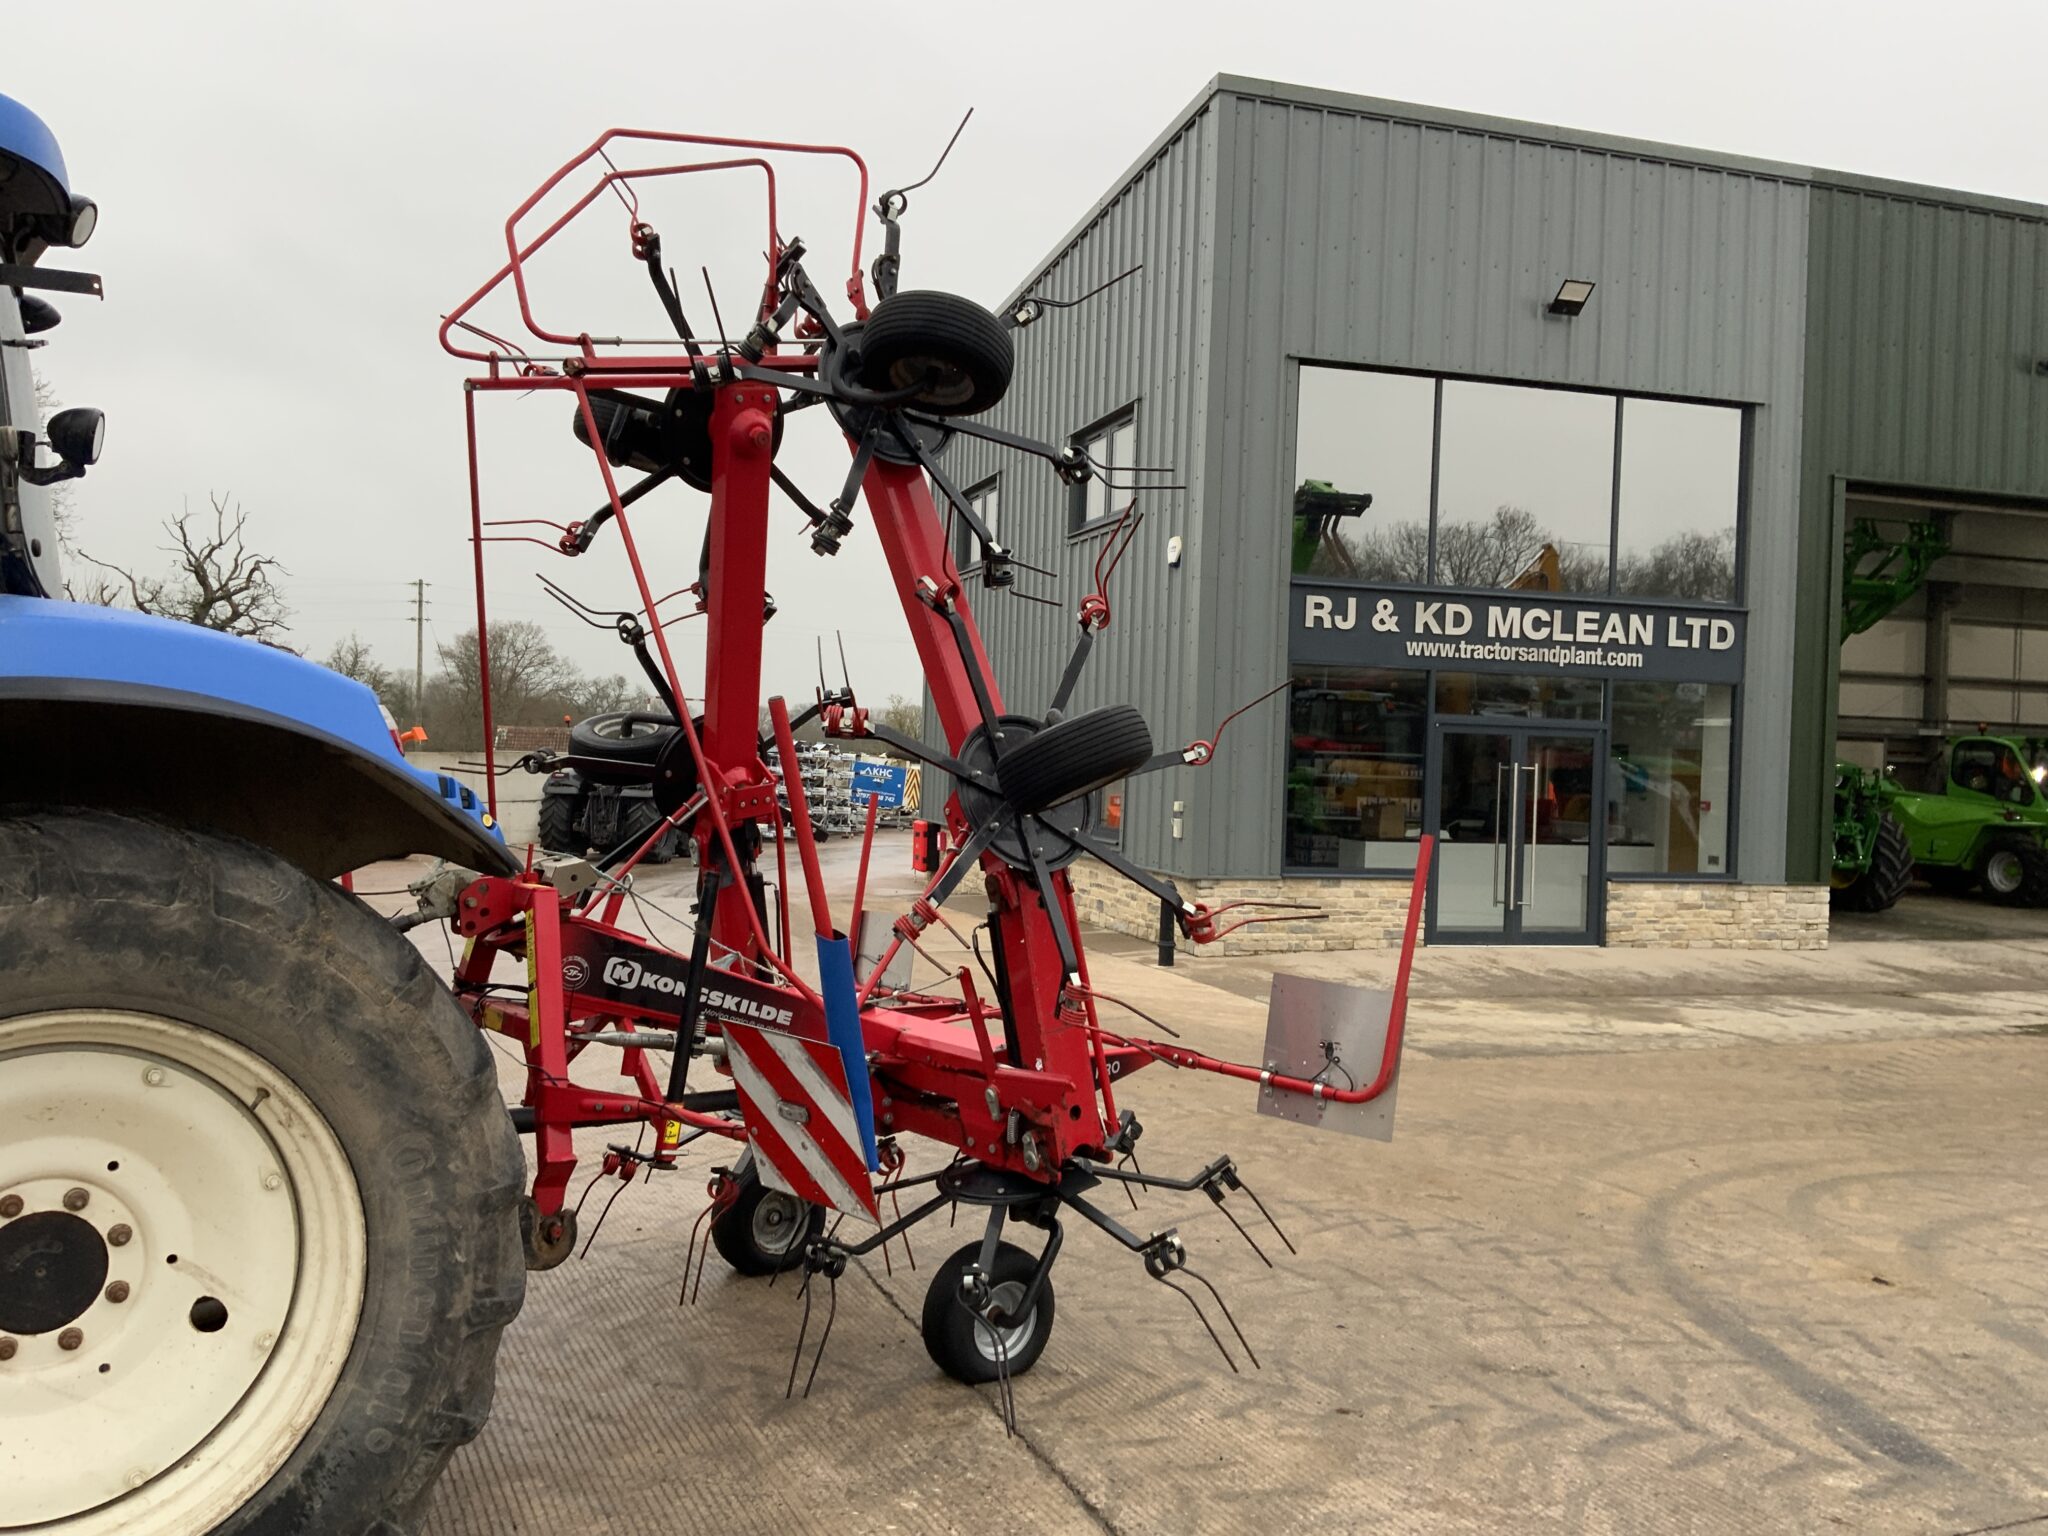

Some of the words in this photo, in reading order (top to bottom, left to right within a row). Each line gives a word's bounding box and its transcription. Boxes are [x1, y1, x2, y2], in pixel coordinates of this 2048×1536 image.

[1304, 595, 1357, 631] RJ
[1371, 598, 1400, 633] &
[1414, 601, 1473, 636] KD
[1487, 606, 1653, 646] MCLEAN
[1667, 615, 1736, 650] LTD
[1406, 639, 1643, 668] www.tractorsandplant.com
